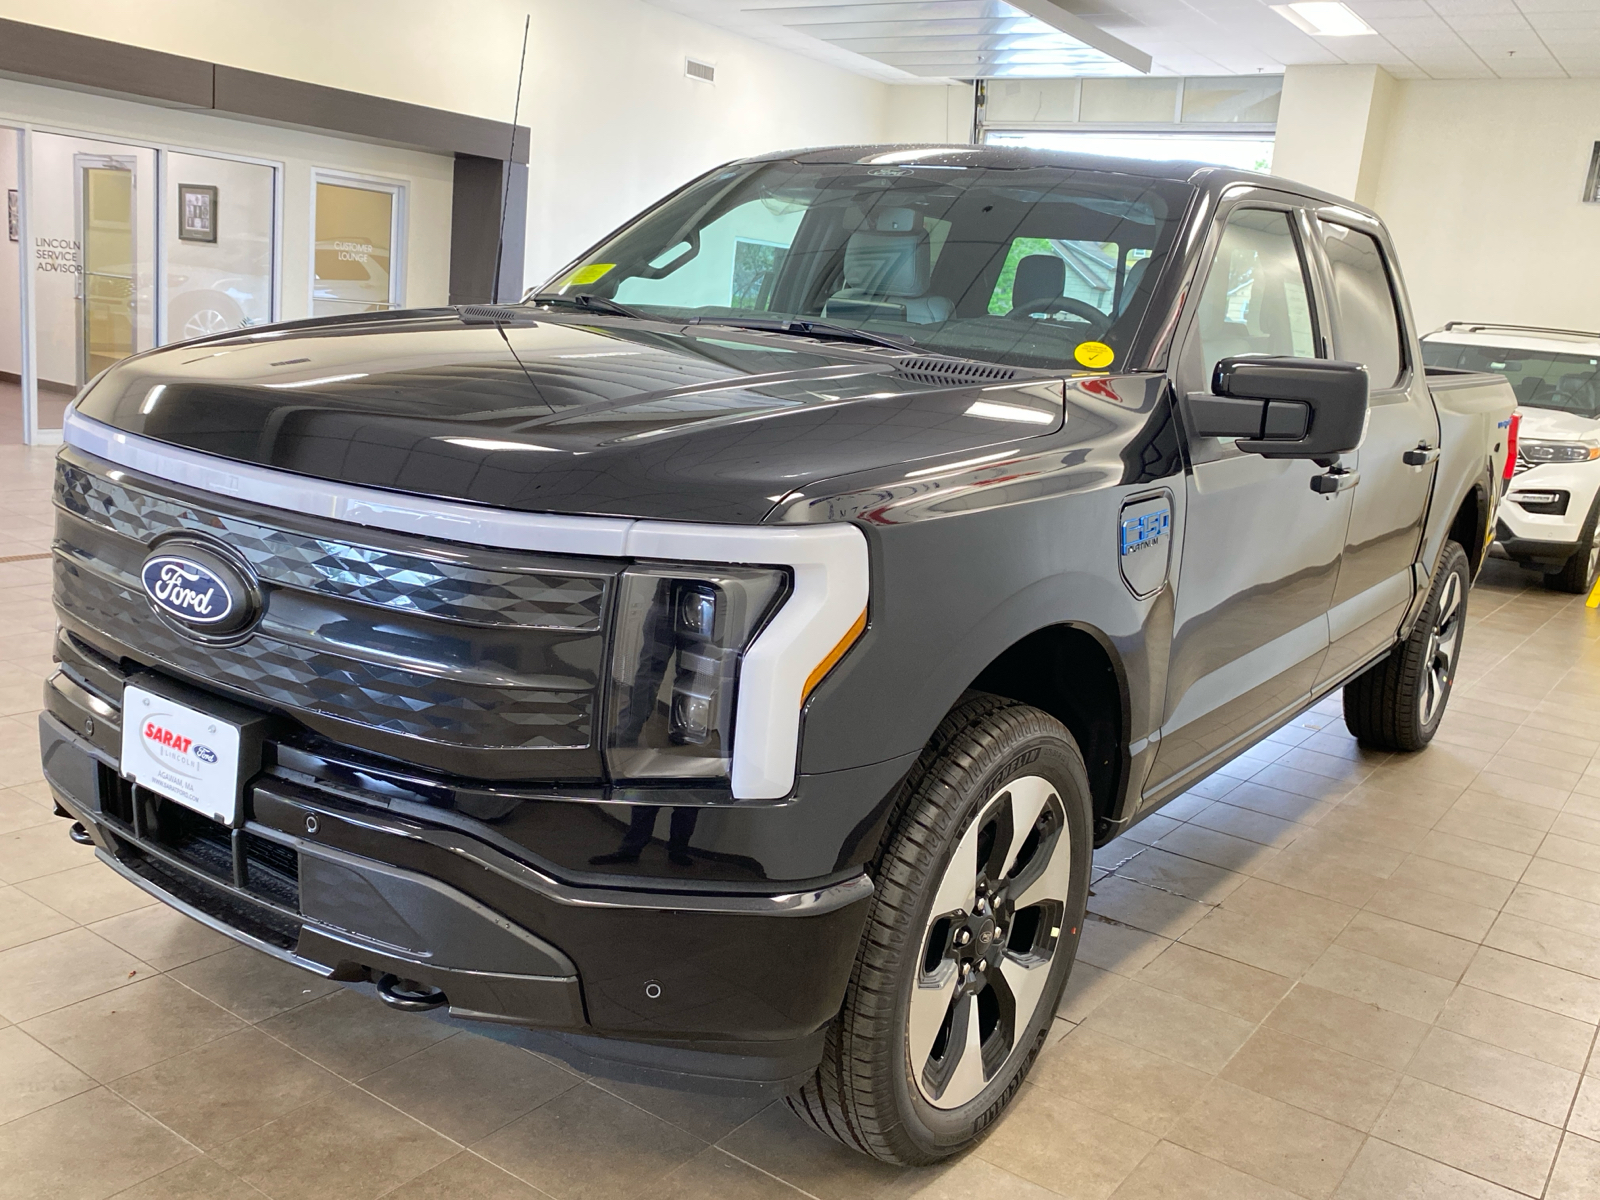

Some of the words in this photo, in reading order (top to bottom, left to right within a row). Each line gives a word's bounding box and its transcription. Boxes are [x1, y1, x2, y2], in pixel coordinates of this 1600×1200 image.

[35, 237, 81, 250] LINCOLN
[334, 241, 373, 253] CUSTOMER
[36, 249, 77, 262] SERVICE
[338, 251, 368, 263] LOUNGE
[37, 262, 83, 274] ADVISOR
[155, 564, 214, 616] Ford
[144, 721, 193, 755] SARAT
[196, 745, 216, 764] Ford
[164, 749, 196, 768] LINCOLN
[157, 770, 184, 788] AGAWAM,
[185, 781, 195, 792] MA
